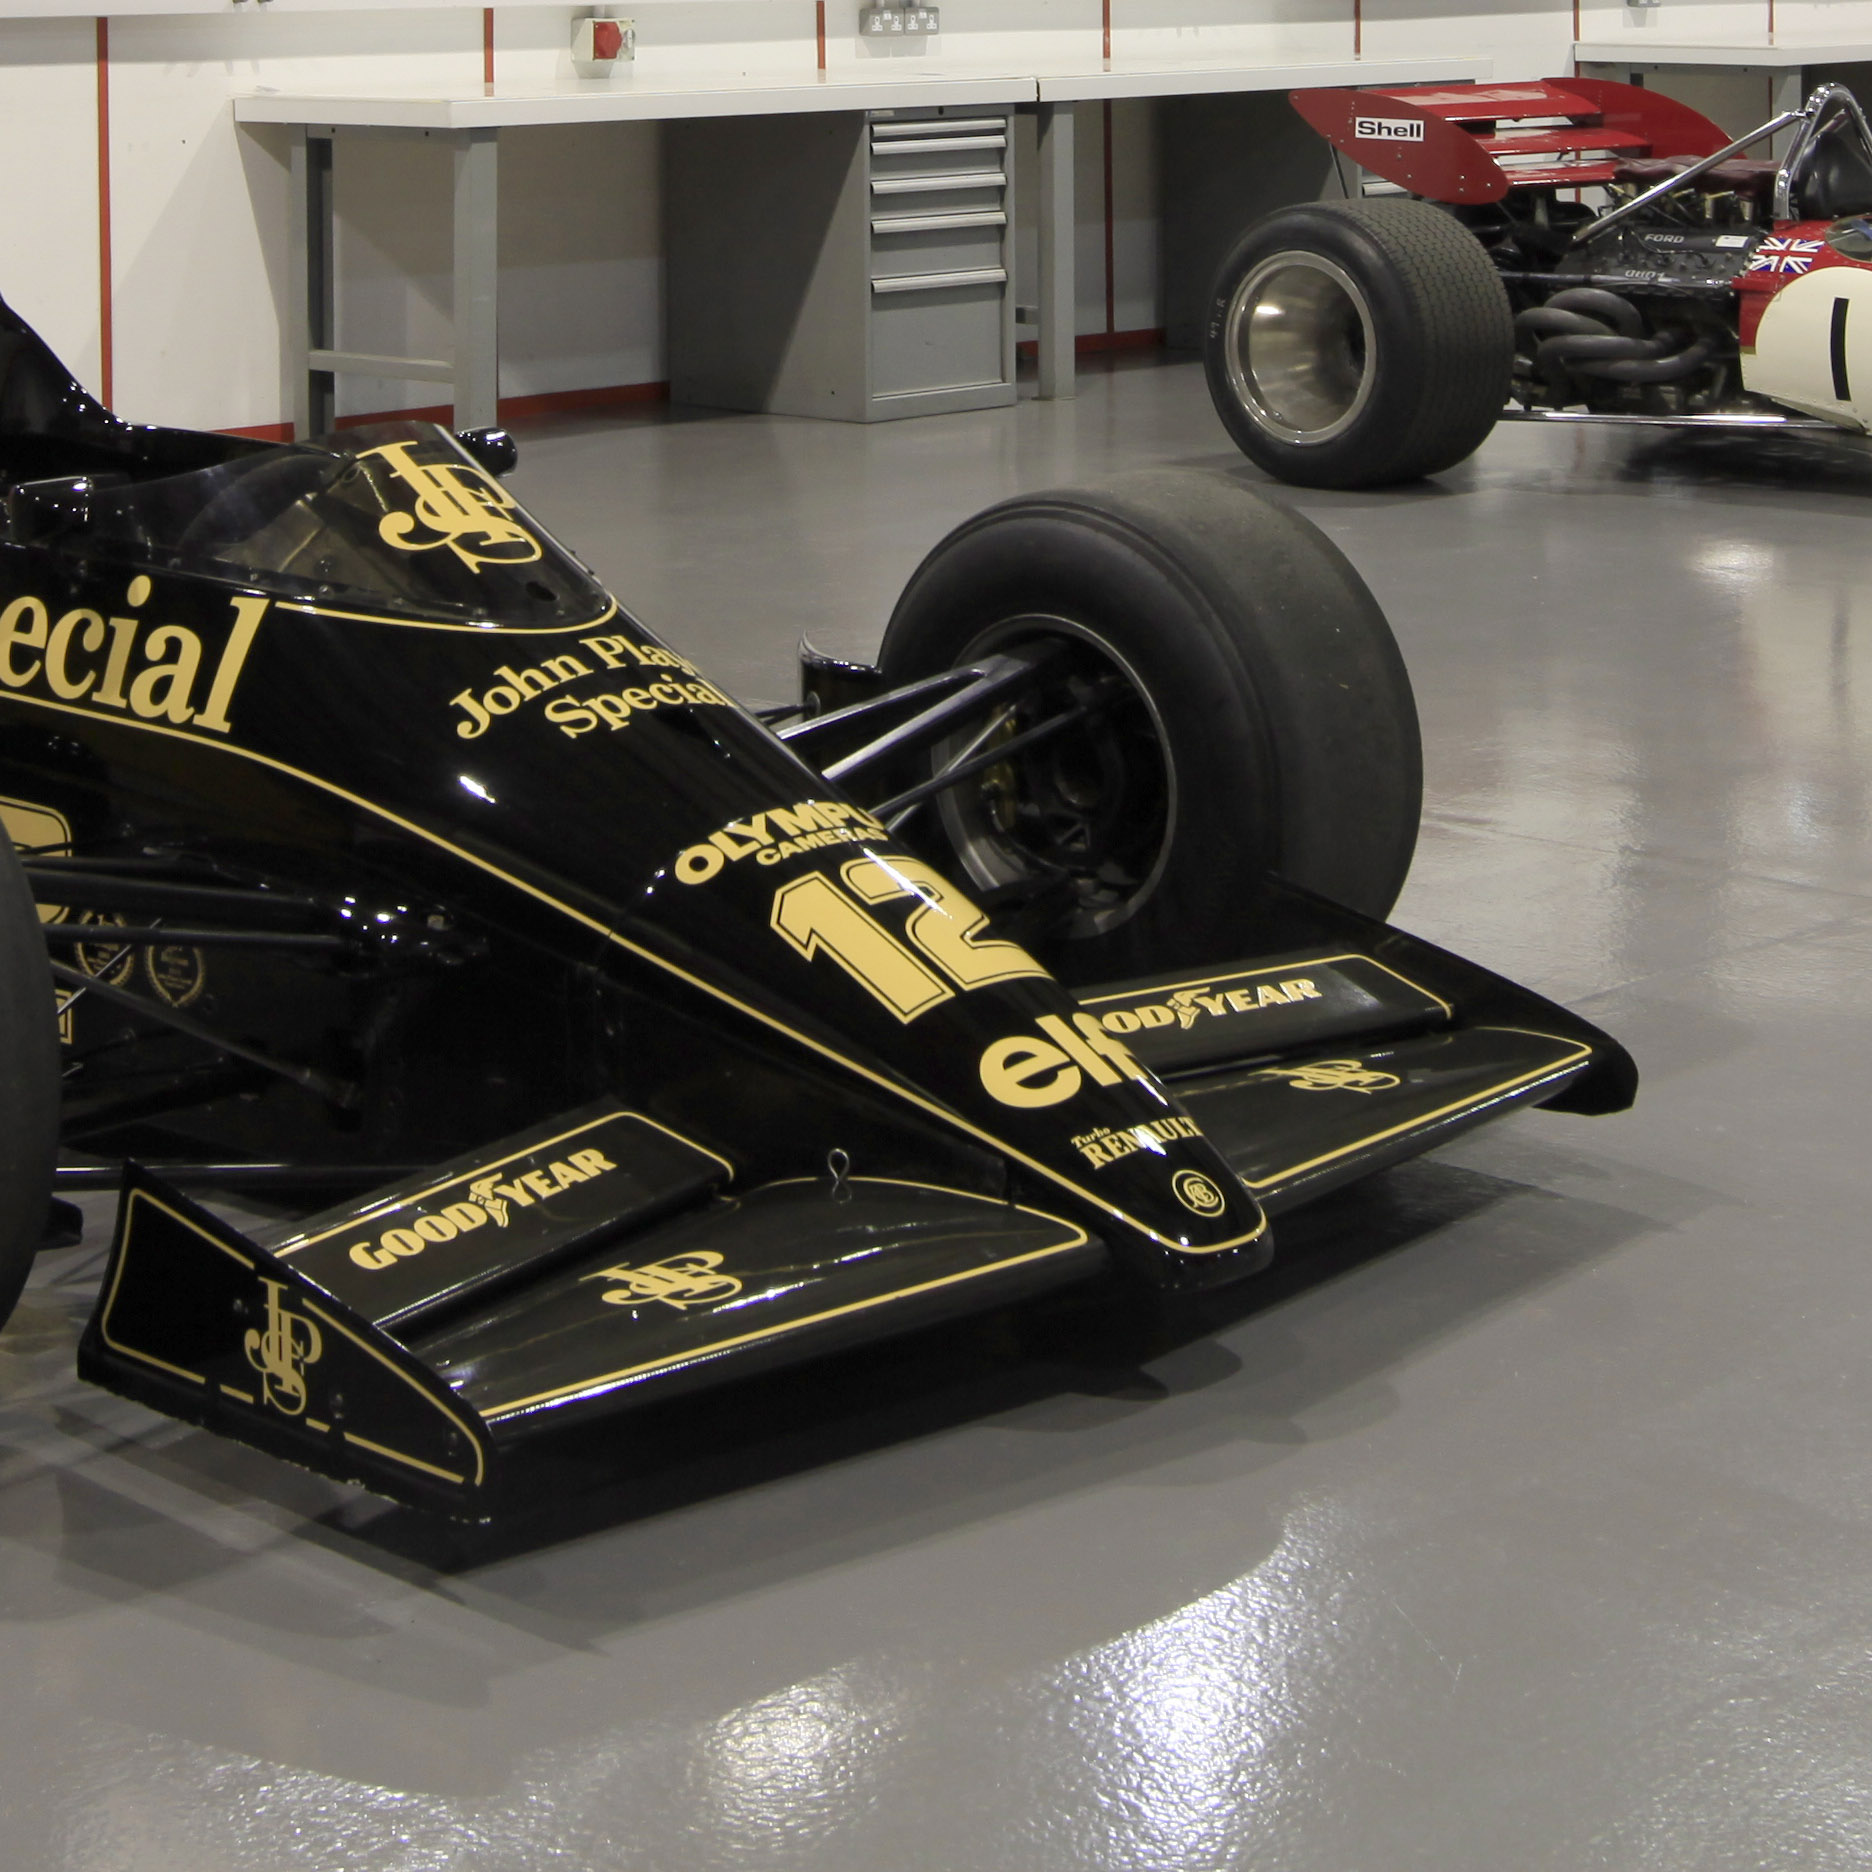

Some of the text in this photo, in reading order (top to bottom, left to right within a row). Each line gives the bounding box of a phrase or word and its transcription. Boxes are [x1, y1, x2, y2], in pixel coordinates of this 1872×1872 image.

[1357, 120, 1422, 138] Shell
[1644, 233, 1685, 245] FORD
[1830, 297, 1851, 402] 1
[448, 652, 594, 741] John
[544, 674, 735, 739] Special
[674, 801, 886, 885] OLYMPU
[756, 827, 889, 866] CAMERAS
[770, 854, 1060, 1025] 12
[979, 1012, 1150, 1109] elf
[1070, 1126, 1112, 1150] Turbo
[1080, 1116, 1205, 1170] RENAULT
